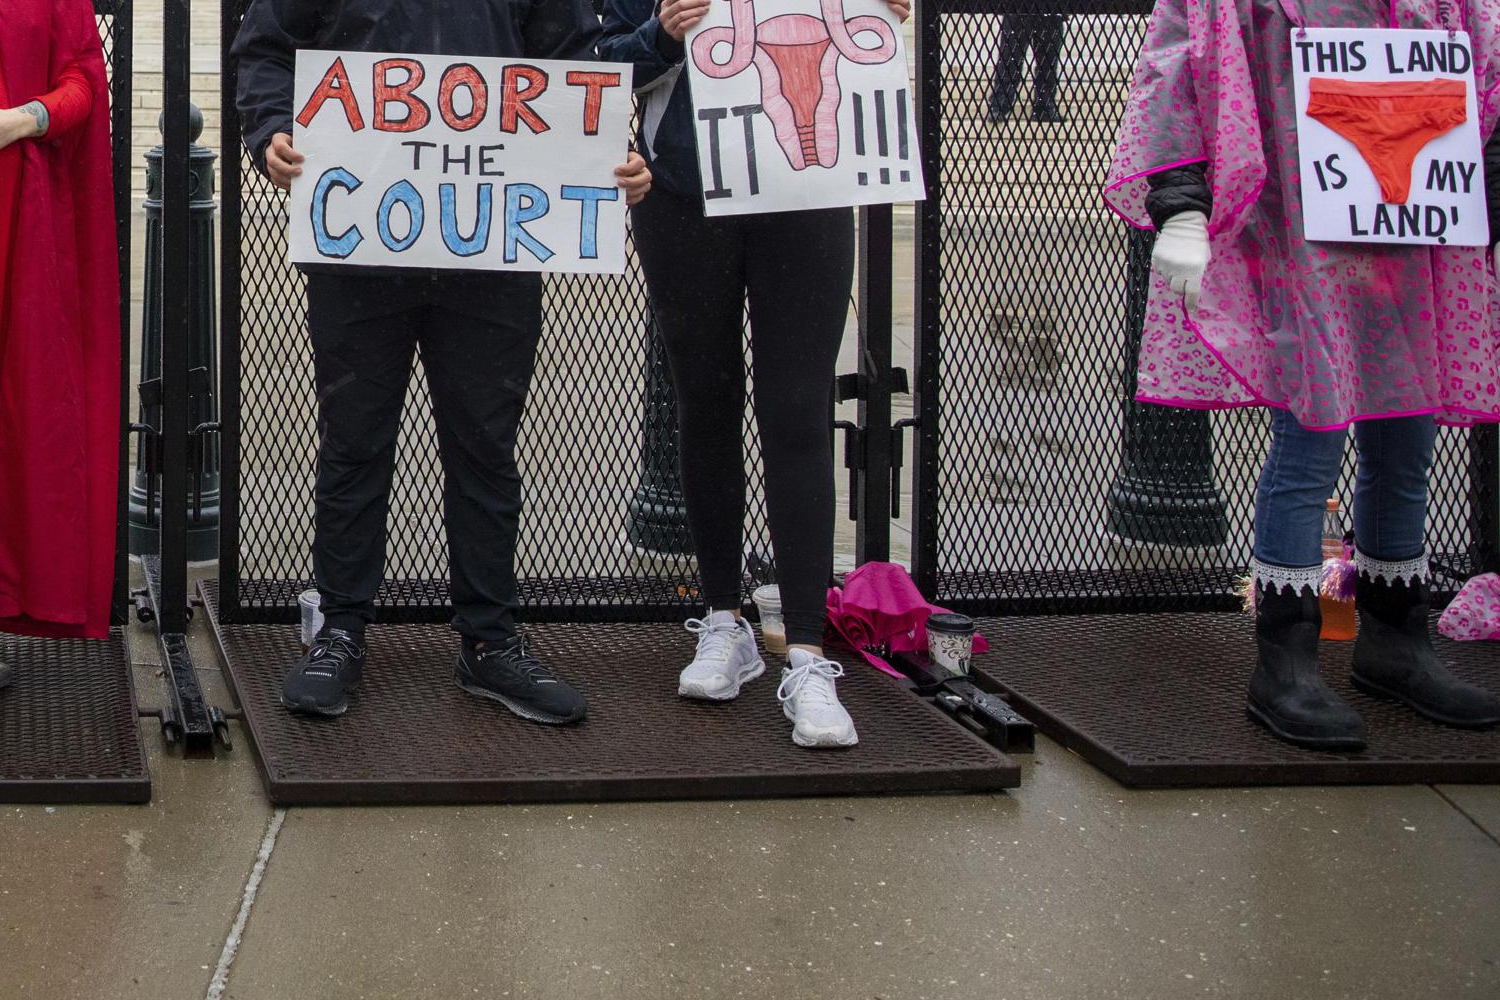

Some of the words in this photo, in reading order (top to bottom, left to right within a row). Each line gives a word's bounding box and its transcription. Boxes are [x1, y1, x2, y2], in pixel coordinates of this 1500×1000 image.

[1295, 40, 1367, 73] THIS
[1384, 40, 1471, 75] LAND
[295, 56, 621, 136] ABORT
[401, 140, 505, 176] THE
[697, 103, 763, 200] IT
[1313, 153, 1348, 192] IS
[1425, 159, 1477, 194] MY
[310, 166, 619, 264] COURT
[1349, 203, 1459, 245] LAND!
